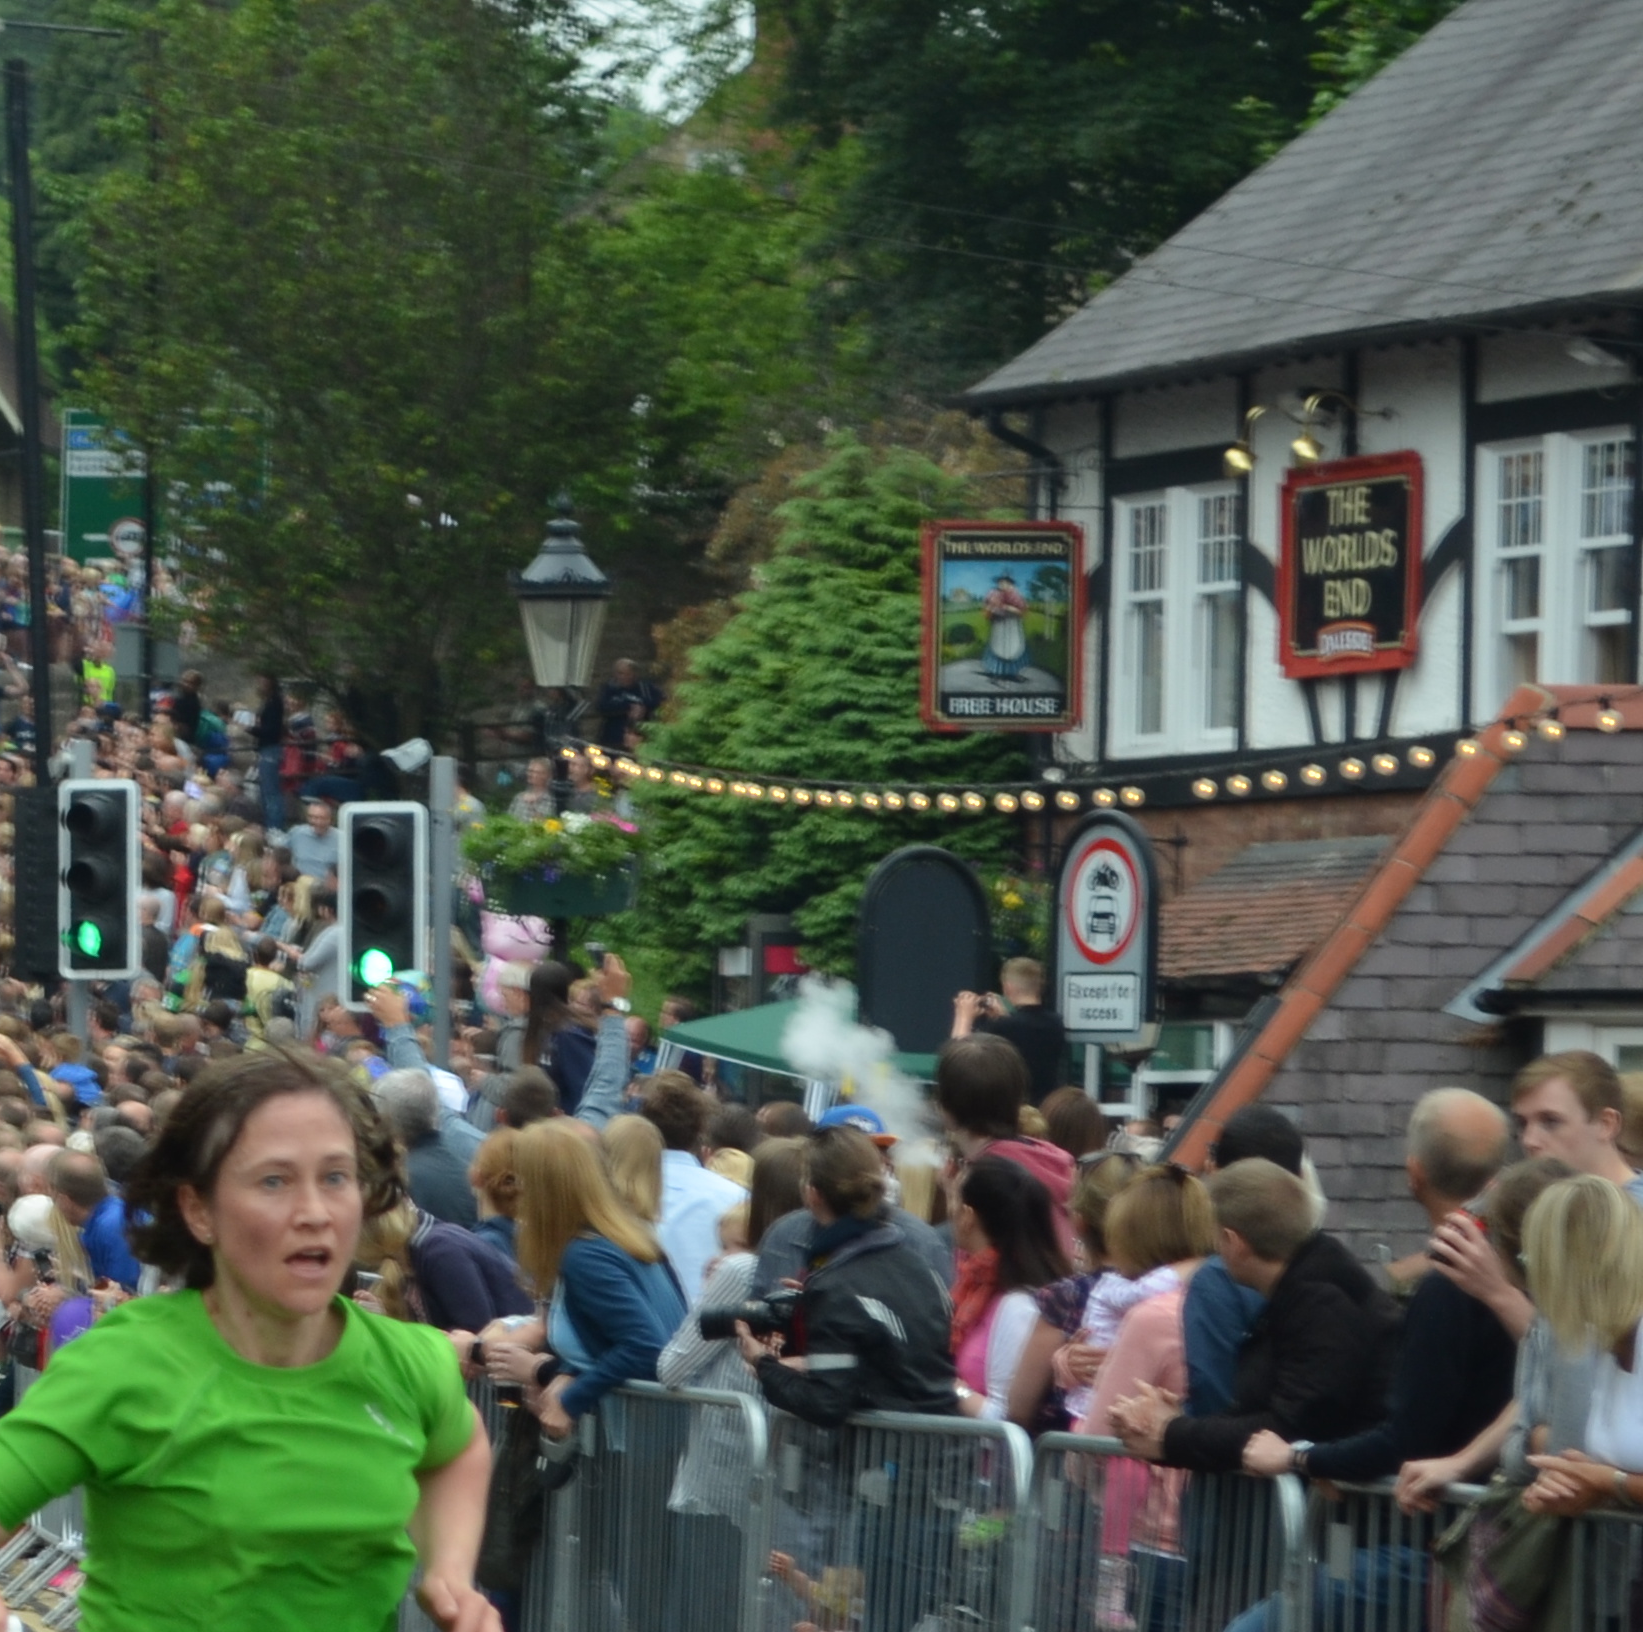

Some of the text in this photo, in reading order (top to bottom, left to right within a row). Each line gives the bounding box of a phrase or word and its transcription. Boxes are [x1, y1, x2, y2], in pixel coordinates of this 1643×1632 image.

[1327, 486, 1372, 526] THE
[1301, 529, 1398, 575] WORLDS
[1323, 578, 1373, 618] END
[948, 696, 1060, 715] FREE HOUSE
[1068, 982, 1109, 1001] Except
[1080, 1007, 1124, 1021] access
